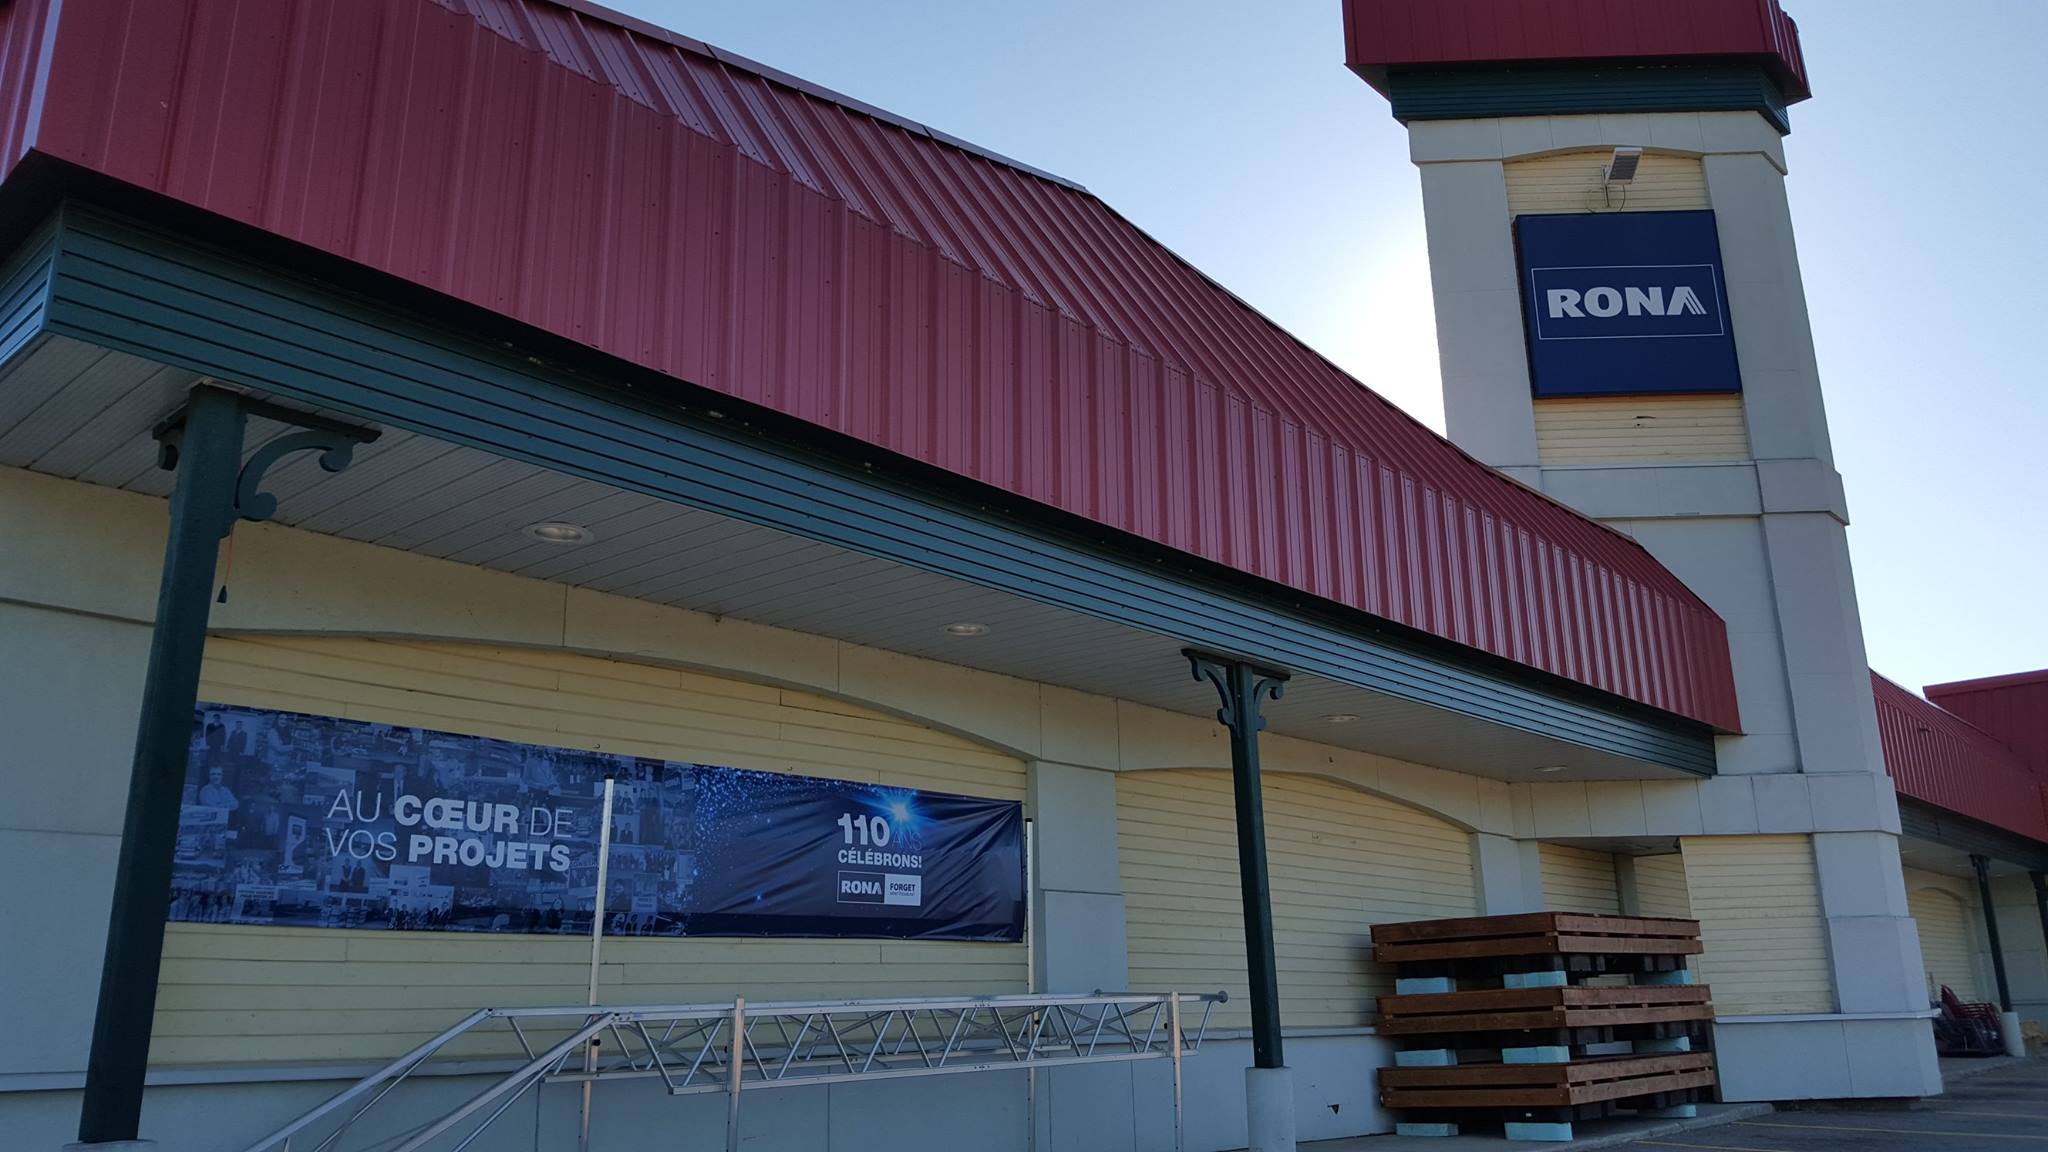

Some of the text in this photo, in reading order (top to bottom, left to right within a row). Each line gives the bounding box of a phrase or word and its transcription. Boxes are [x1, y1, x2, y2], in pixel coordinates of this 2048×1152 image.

[1547, 286, 1707, 318] RONA
[327, 788, 573, 838] AU CŒUR DE
[837, 813, 890, 847] 110
[326, 827, 571, 872] VOS PROJETS
[838, 847, 922, 869] CÉLÉBRONS!
[841, 880, 882, 895] RONA
[889, 882, 916, 892] FORGET
